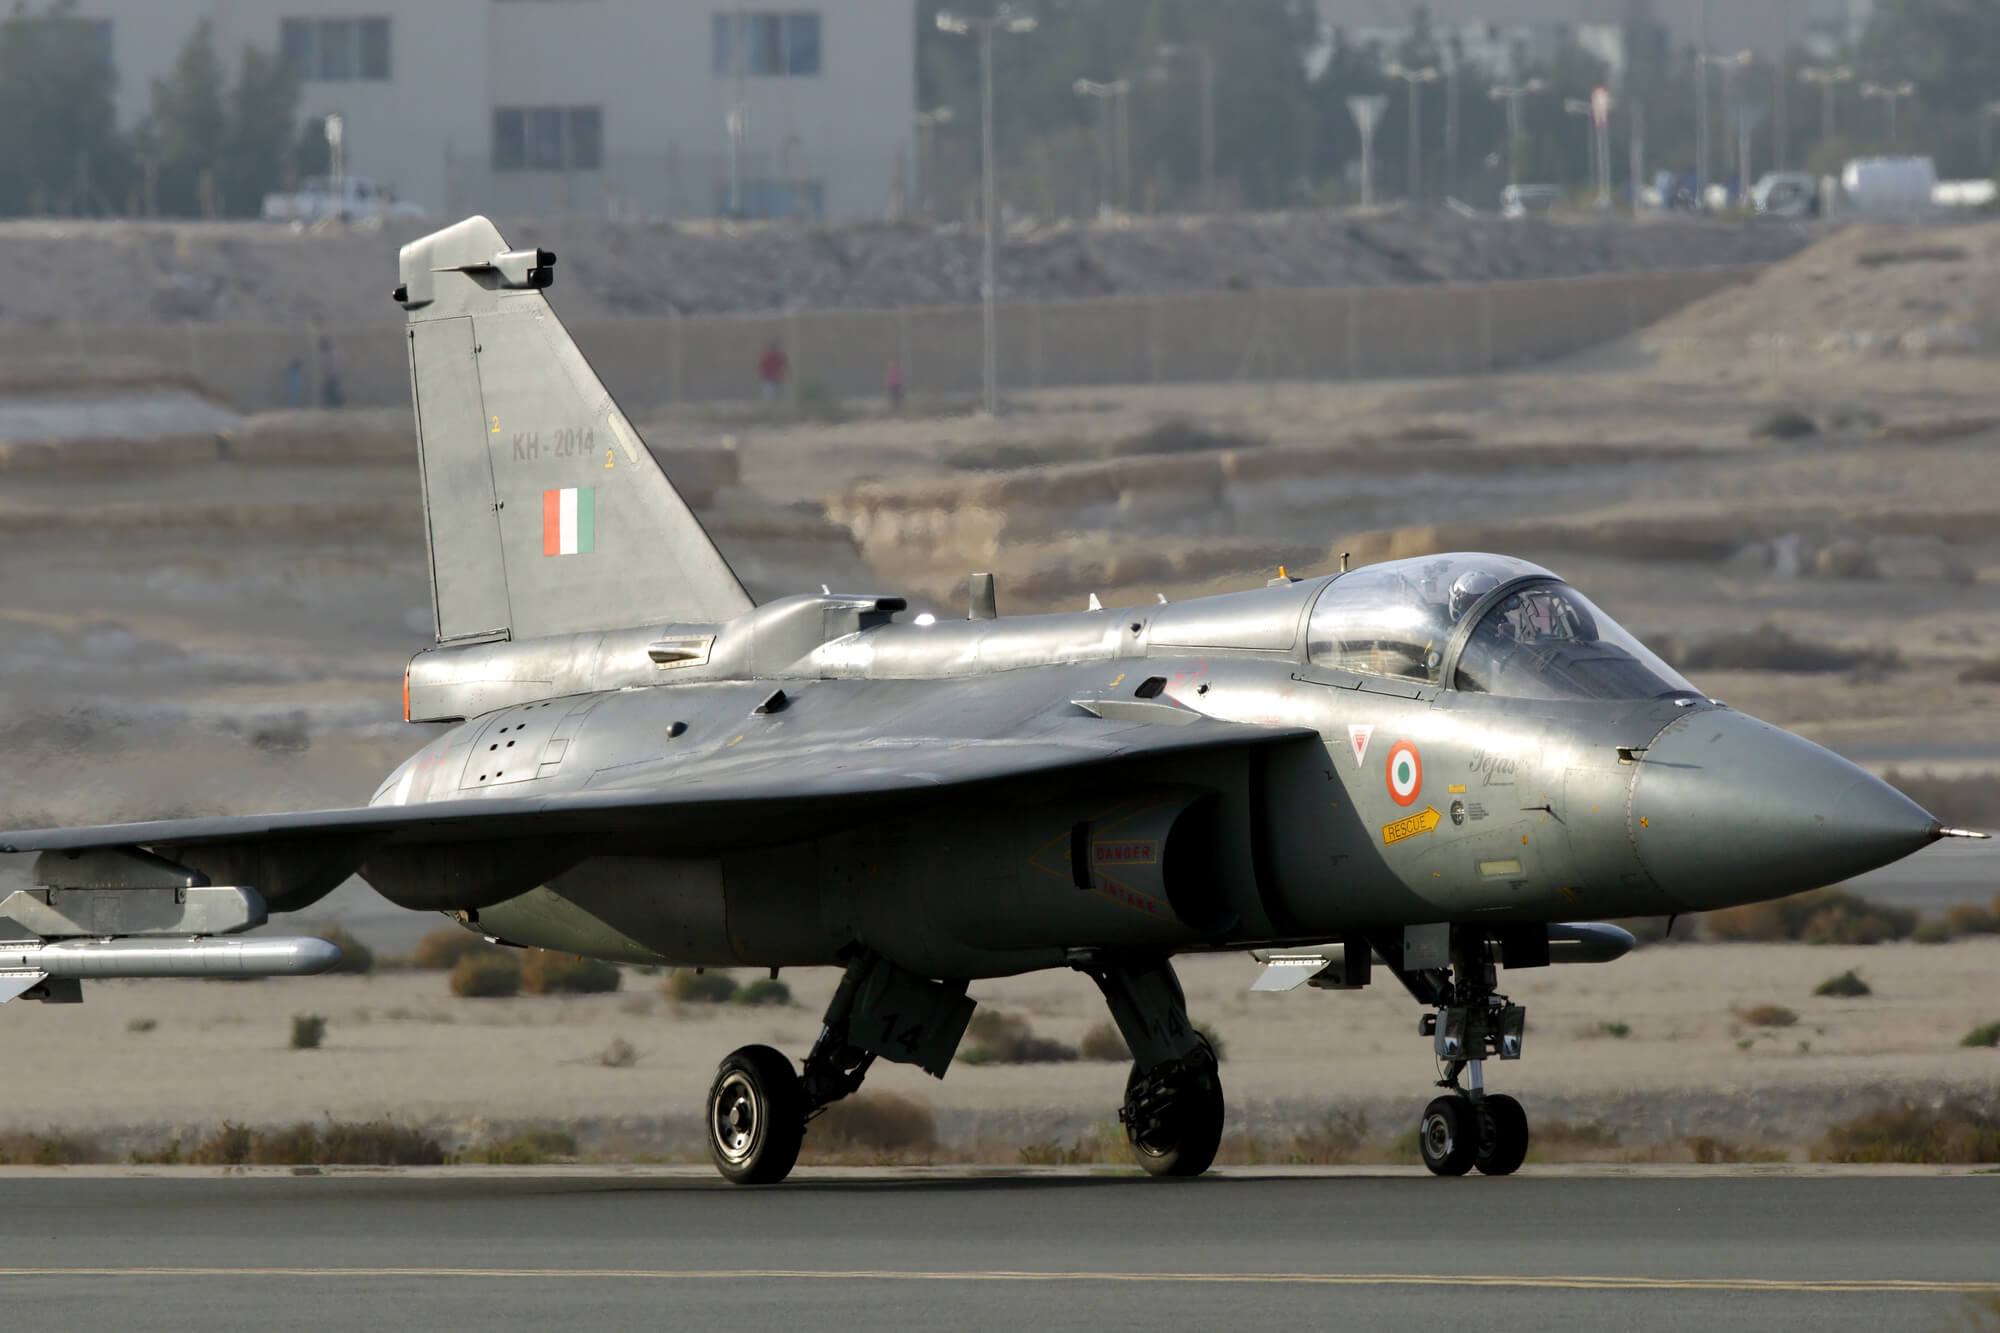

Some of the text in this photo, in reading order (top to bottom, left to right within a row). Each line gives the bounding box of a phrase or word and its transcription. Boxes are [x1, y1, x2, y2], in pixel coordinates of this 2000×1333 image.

[1387, 815, 1427, 840] RESCUE
[1096, 845, 1152, 861] DANGER
[1103, 879, 1155, 912] INTAKE
[881, 1013, 924, 1055] 14
[1152, 1005, 1185, 1048] 14
